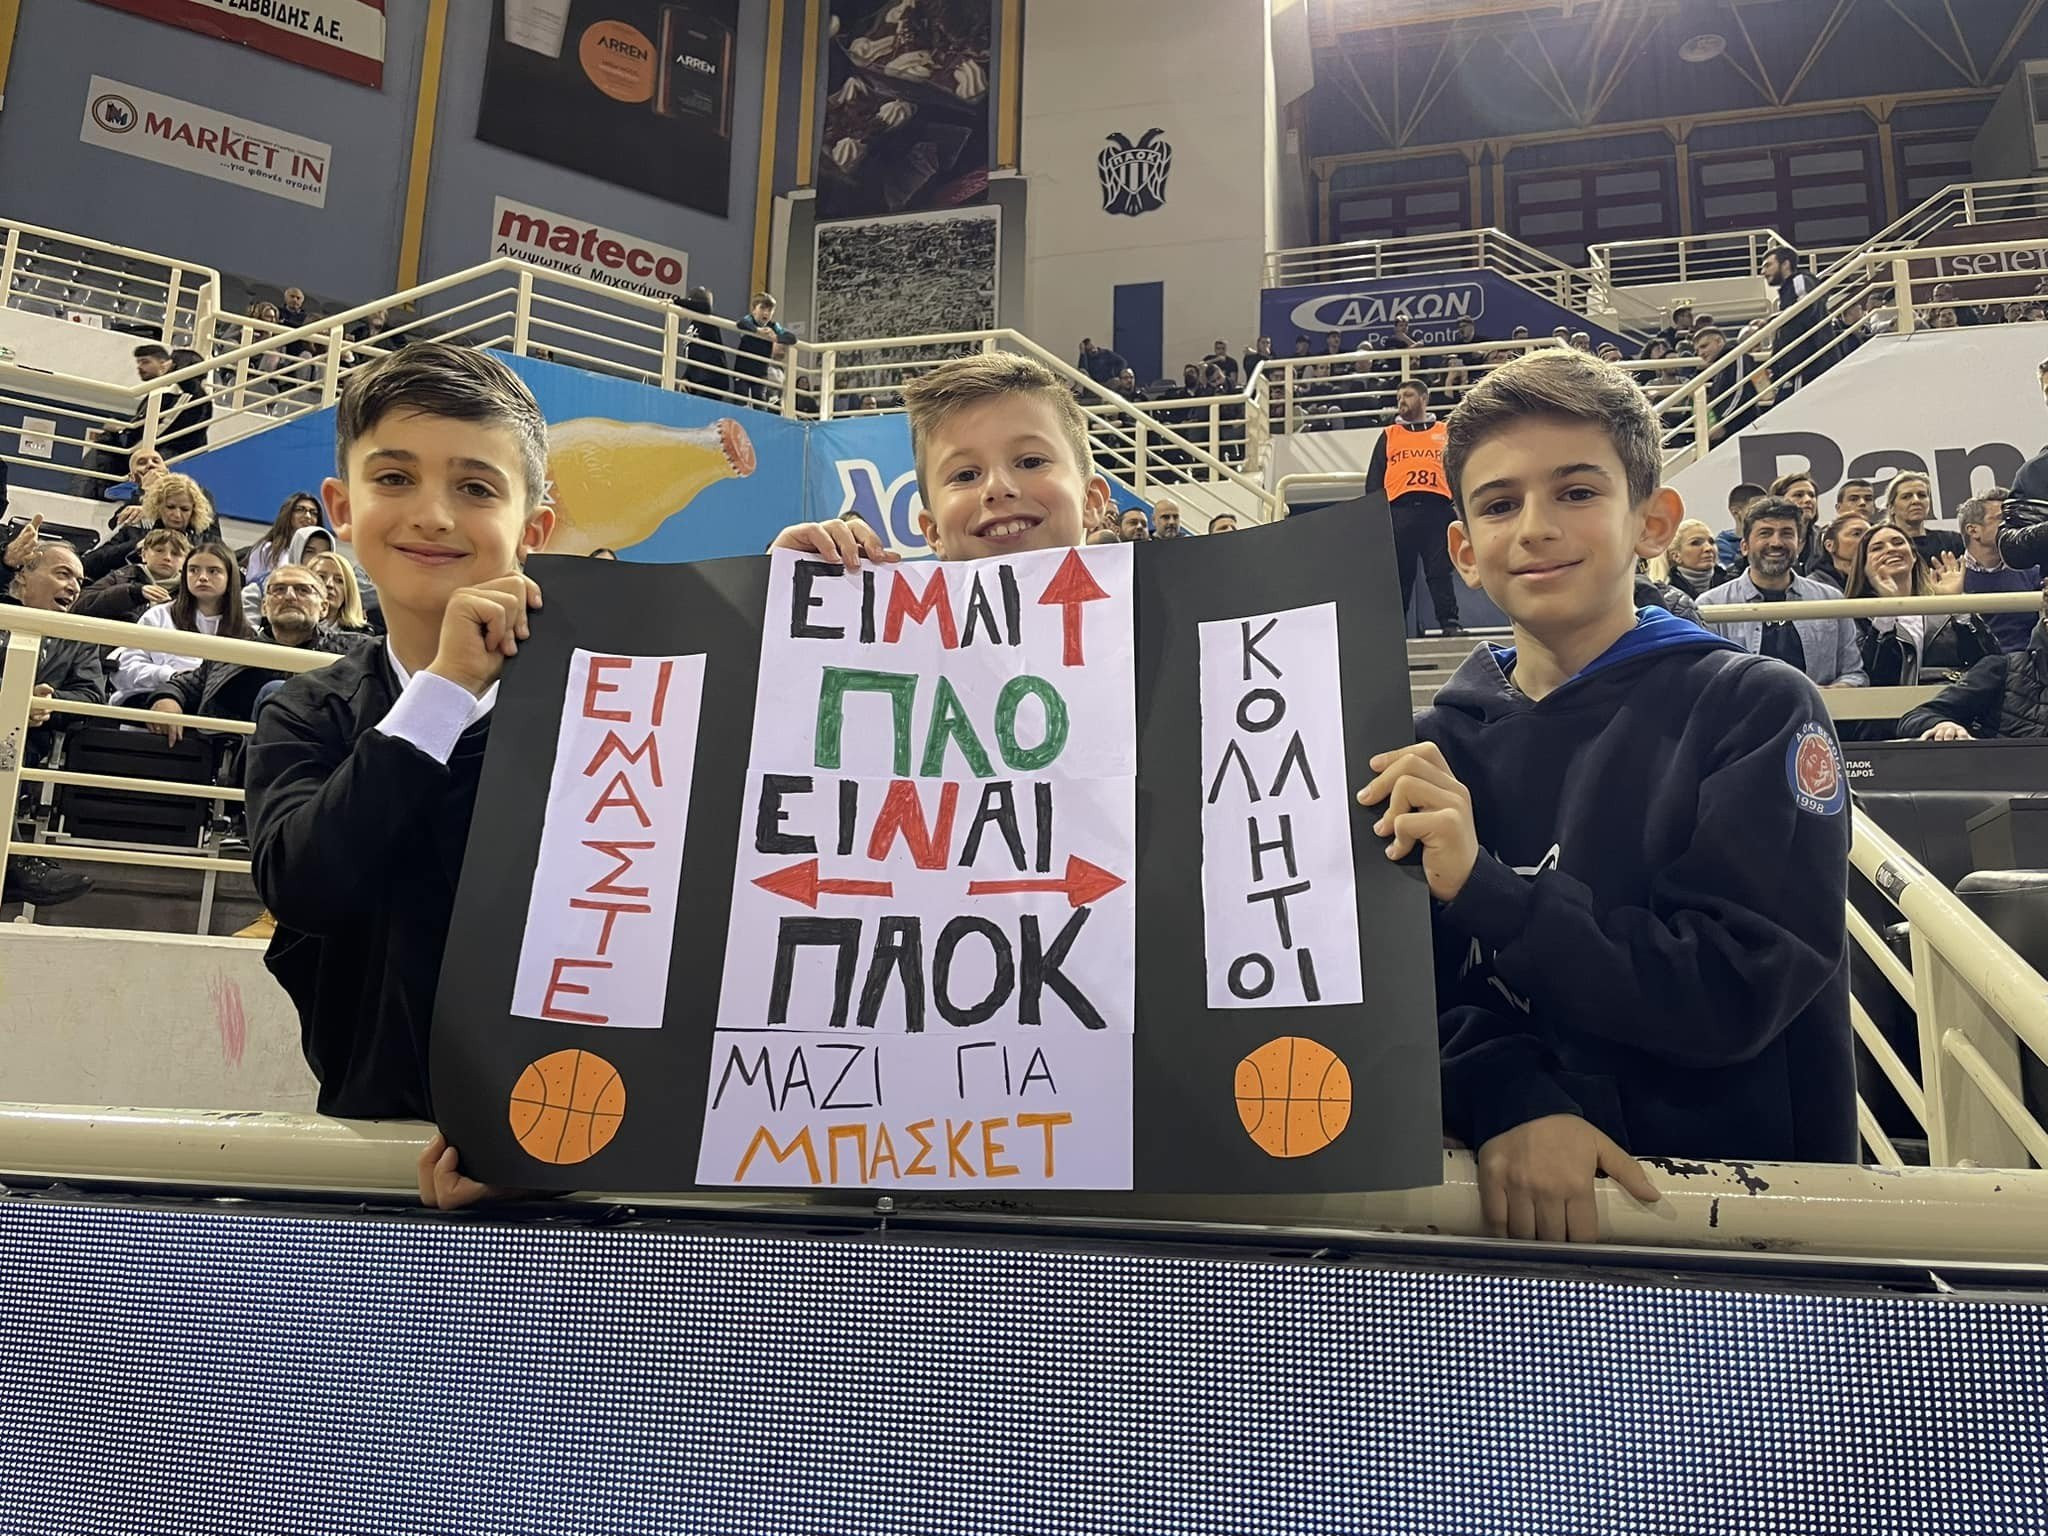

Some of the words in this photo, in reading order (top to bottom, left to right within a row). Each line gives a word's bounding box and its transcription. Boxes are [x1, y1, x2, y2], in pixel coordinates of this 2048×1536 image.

[313, 15, 344, 42] Α.Ε.
[597, 35, 648, 61] ARREN
[676, 54, 716, 75] ARREN
[291, 155, 325, 184] IN
[1111, 151, 1157, 166] ΠΑΟΚ
[496, 242, 582, 275] Ανυψωτικά
[498, 210, 682, 286] mateco
[1337, 290, 1472, 326] ΑΛΚΩΝ
[1412, 328, 1459, 345] Contr
[1391, 449, 1442, 466] STEWAR
[1406, 469, 1438, 487] 281
[1739, 431, 2027, 524] Pan
[790, 559, 1022, 650] ΕΙΜΑΙ
[814, 665, 1070, 778] ΠΑΟ
[1846, 760, 1871, 769] ΠΑΟΚ
[1846, 769, 1875, 778] ΕΔΡΟΣ
[1207, 618, 1321, 1002] ΚΟΛΛΗΤΟΙ
[1796, 793, 1825, 813] 1998
[755, 773, 1053, 873] ΕΙΝΑΙ
[541, 656, 674, 1025] ΕΙΜΑΣΤΕ
[766, 905, 1108, 1034] ΠΑΟΚ
[711, 1042, 883, 1113] ΜΑΖΙ
[956, 1040, 1058, 1100] ΓΙΑ
[733, 1111, 1073, 1185] ΜΠΑΣΚΕΤ
